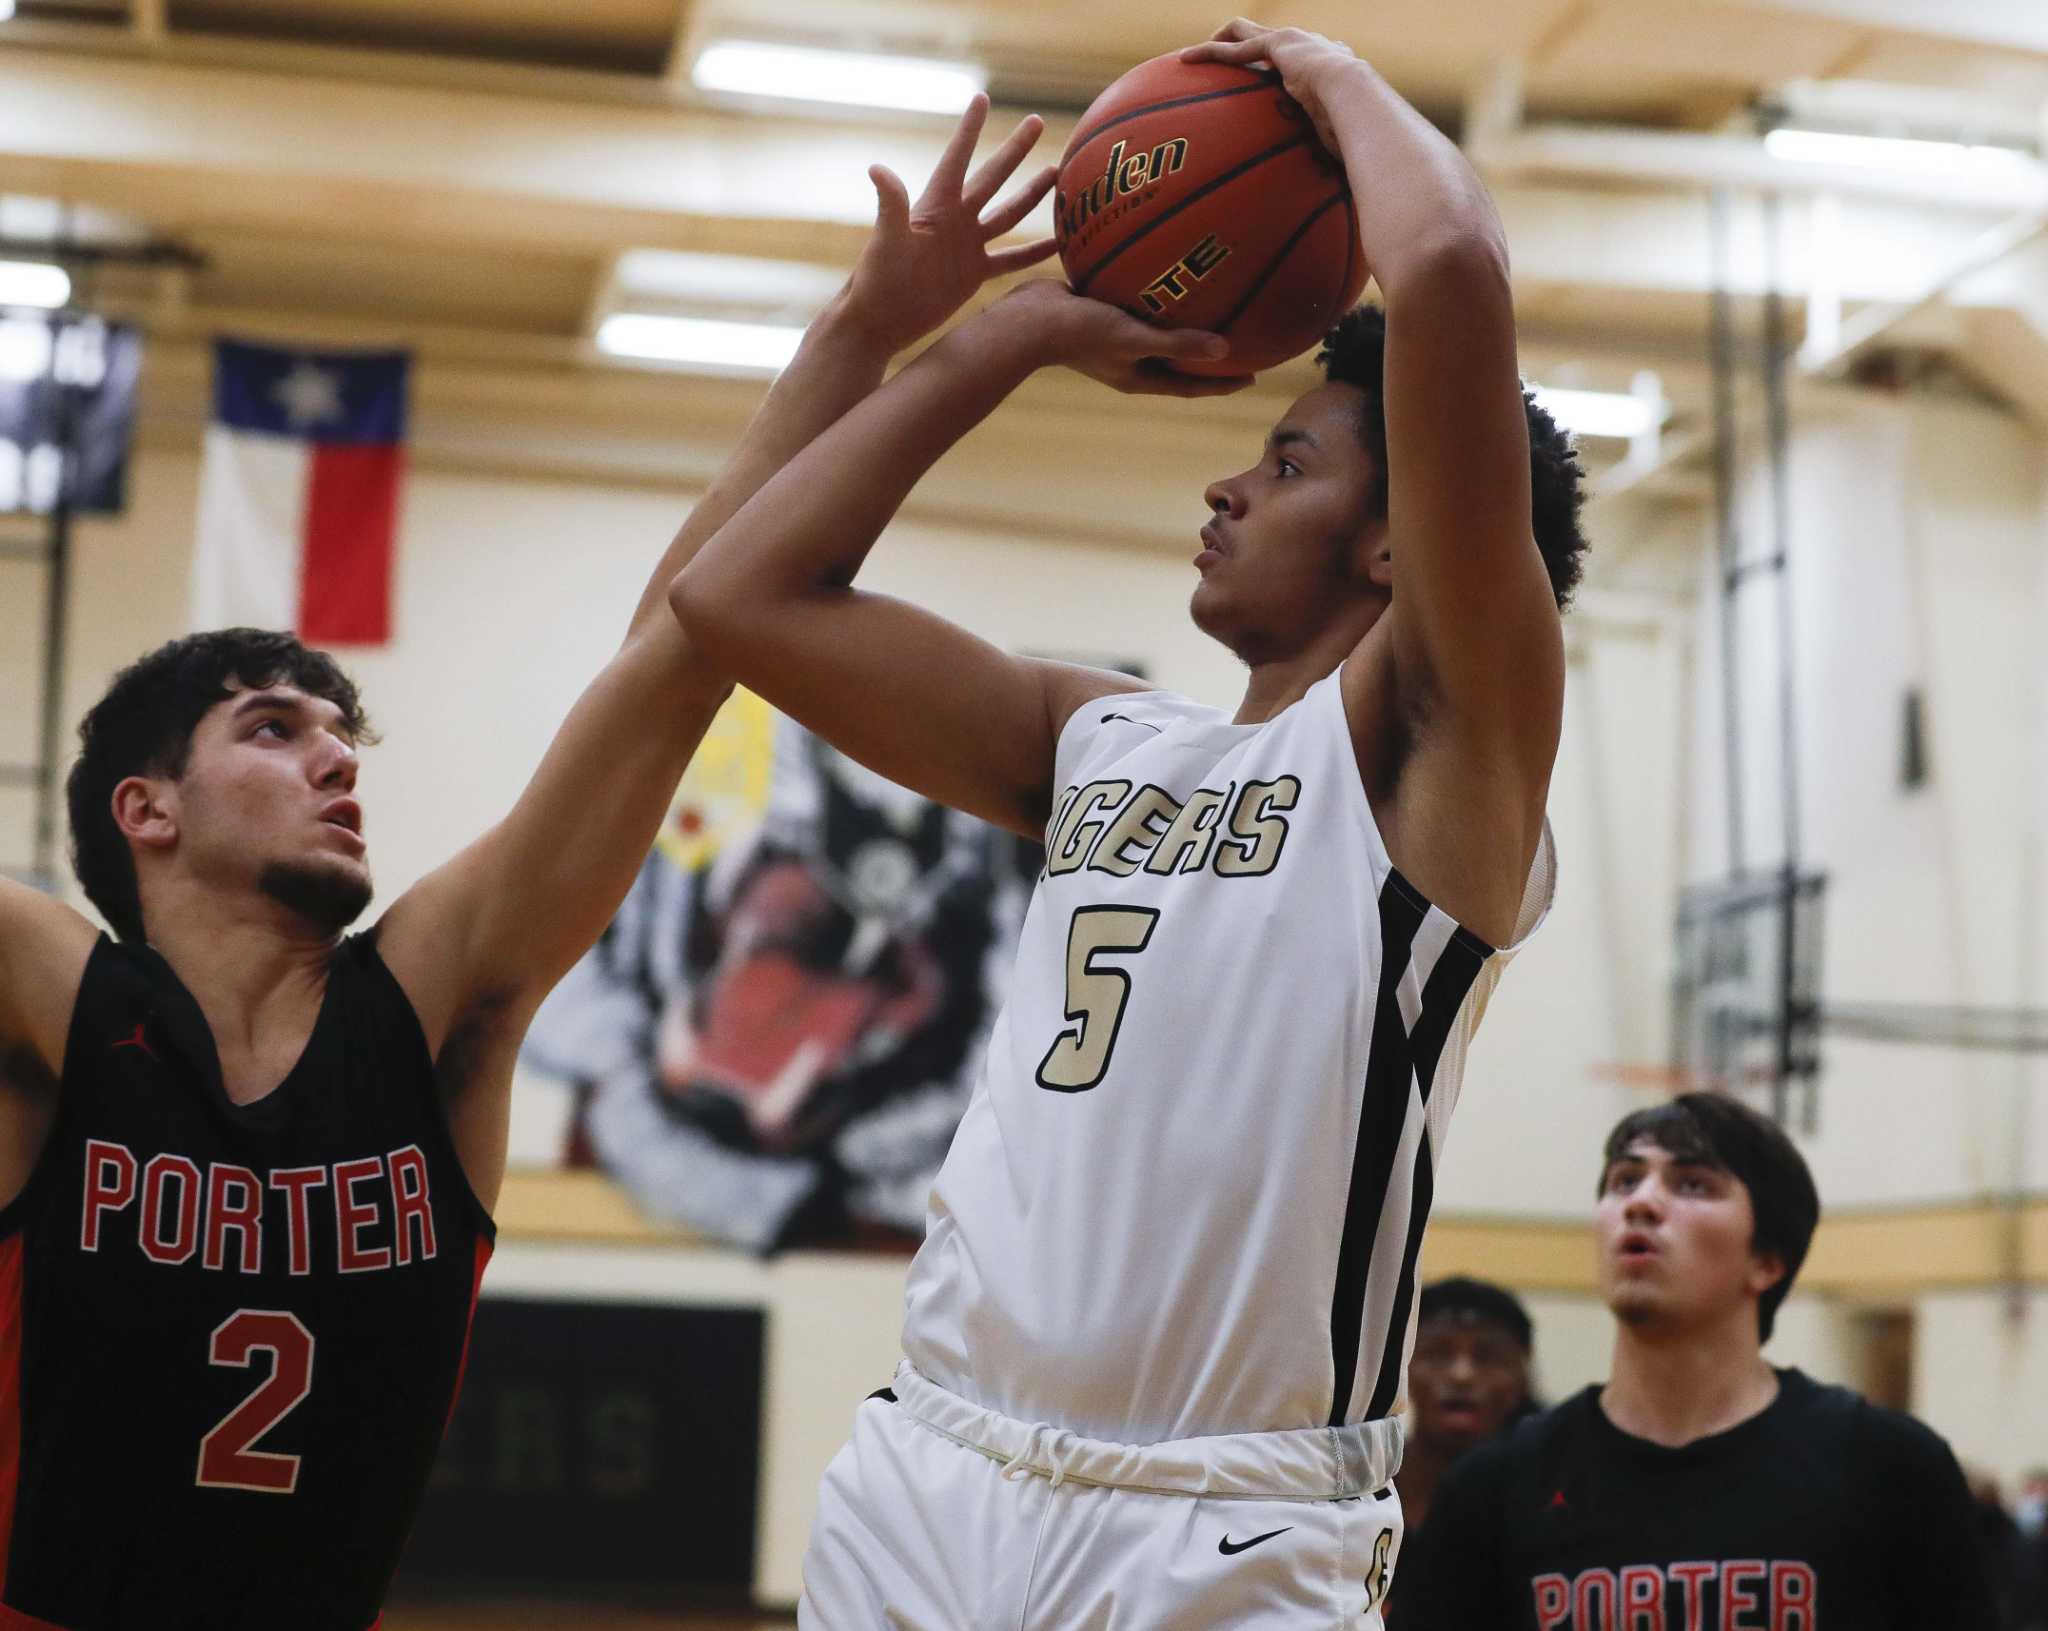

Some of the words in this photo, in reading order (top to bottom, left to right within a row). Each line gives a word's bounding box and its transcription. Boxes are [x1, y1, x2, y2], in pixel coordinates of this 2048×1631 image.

[1138, 232, 1233, 313] ITE
[1035, 904, 1161, 1093] 5
[80, 1138, 437, 1276] PORTER
[196, 1308, 315, 1494] 2
[1532, 1560, 1817, 1631] PORTER
